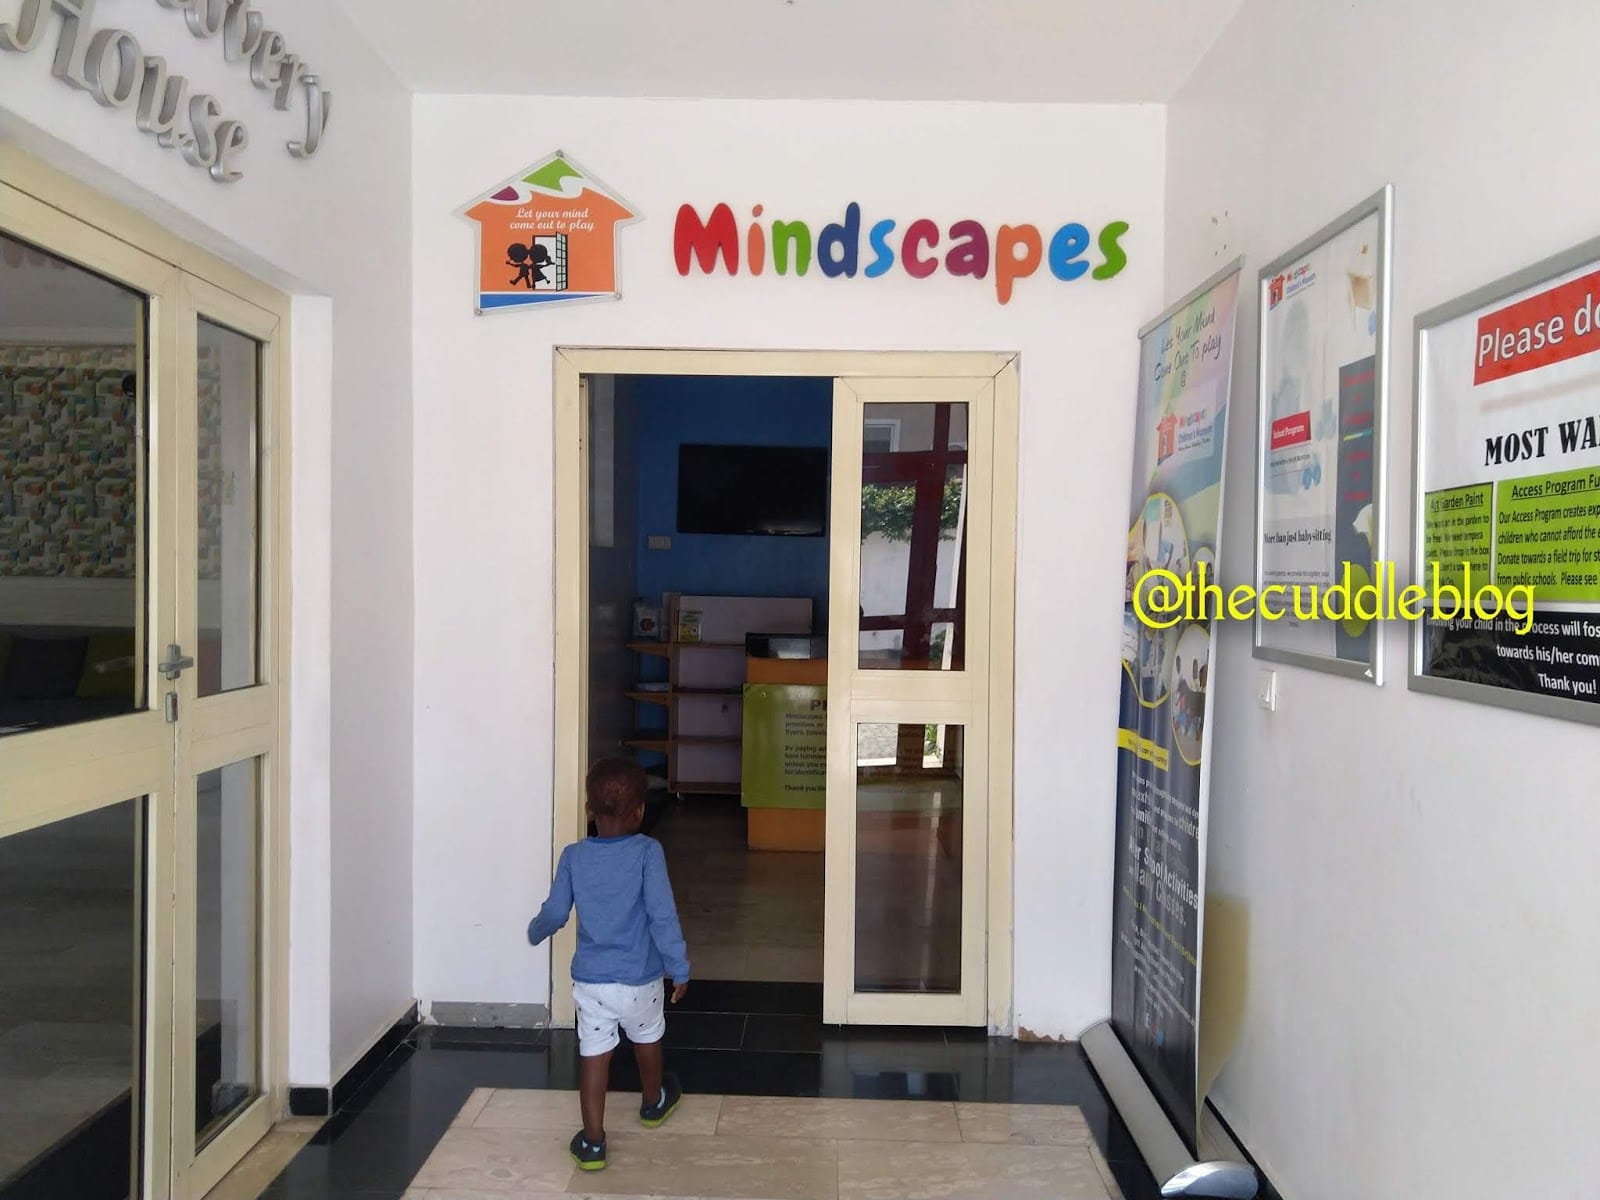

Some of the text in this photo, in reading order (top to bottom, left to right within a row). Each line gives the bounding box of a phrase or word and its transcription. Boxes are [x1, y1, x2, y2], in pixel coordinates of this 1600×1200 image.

[516, 208, 588, 220] Let your mind
[509, 220, 594, 231] come out to play
[673, 201, 1129, 305] Mindscapes
[1201, 334, 1221, 362] play
[1477, 315, 1565, 368] Please
[1484, 416, 1600, 466] MOST WA
[1511, 485, 1543, 498] Access
[1545, 478, 1586, 495] Program
[1465, 492, 1484, 506] Paint
[1499, 511, 1511, 524] Our
[1512, 510, 1534, 522] Access
[1535, 509, 1562, 524] Program
[1562, 504, 1586, 517] creates
[1498, 530, 1523, 544] children
[1524, 528, 1538, 542] who
[1540, 530, 1562, 542] cannot
[1562, 526, 1584, 540] afford
[1584, 525, 1596, 538] the
[1497, 552, 1520, 564] Donate
[1521, 551, 1546, 563] towards
[1553, 549, 1567, 563] field
[1568, 549, 1581, 565] trip
[1582, 547, 1592, 562] for
[1497, 571, 1598, 585] from public schools. Please see
[1456, 618, 1472, 631] your
[1474, 617, 1494, 631] child
[1494, 618, 1504, 631] in
[1504, 618, 1520, 632] the
[1521, 622, 1560, 635] pocess
[1561, 620, 1581, 637] will
[1496, 643, 1534, 660] towards
[1535, 645, 1574, 665] his/her
[1537, 672, 1597, 696] Thank you!
